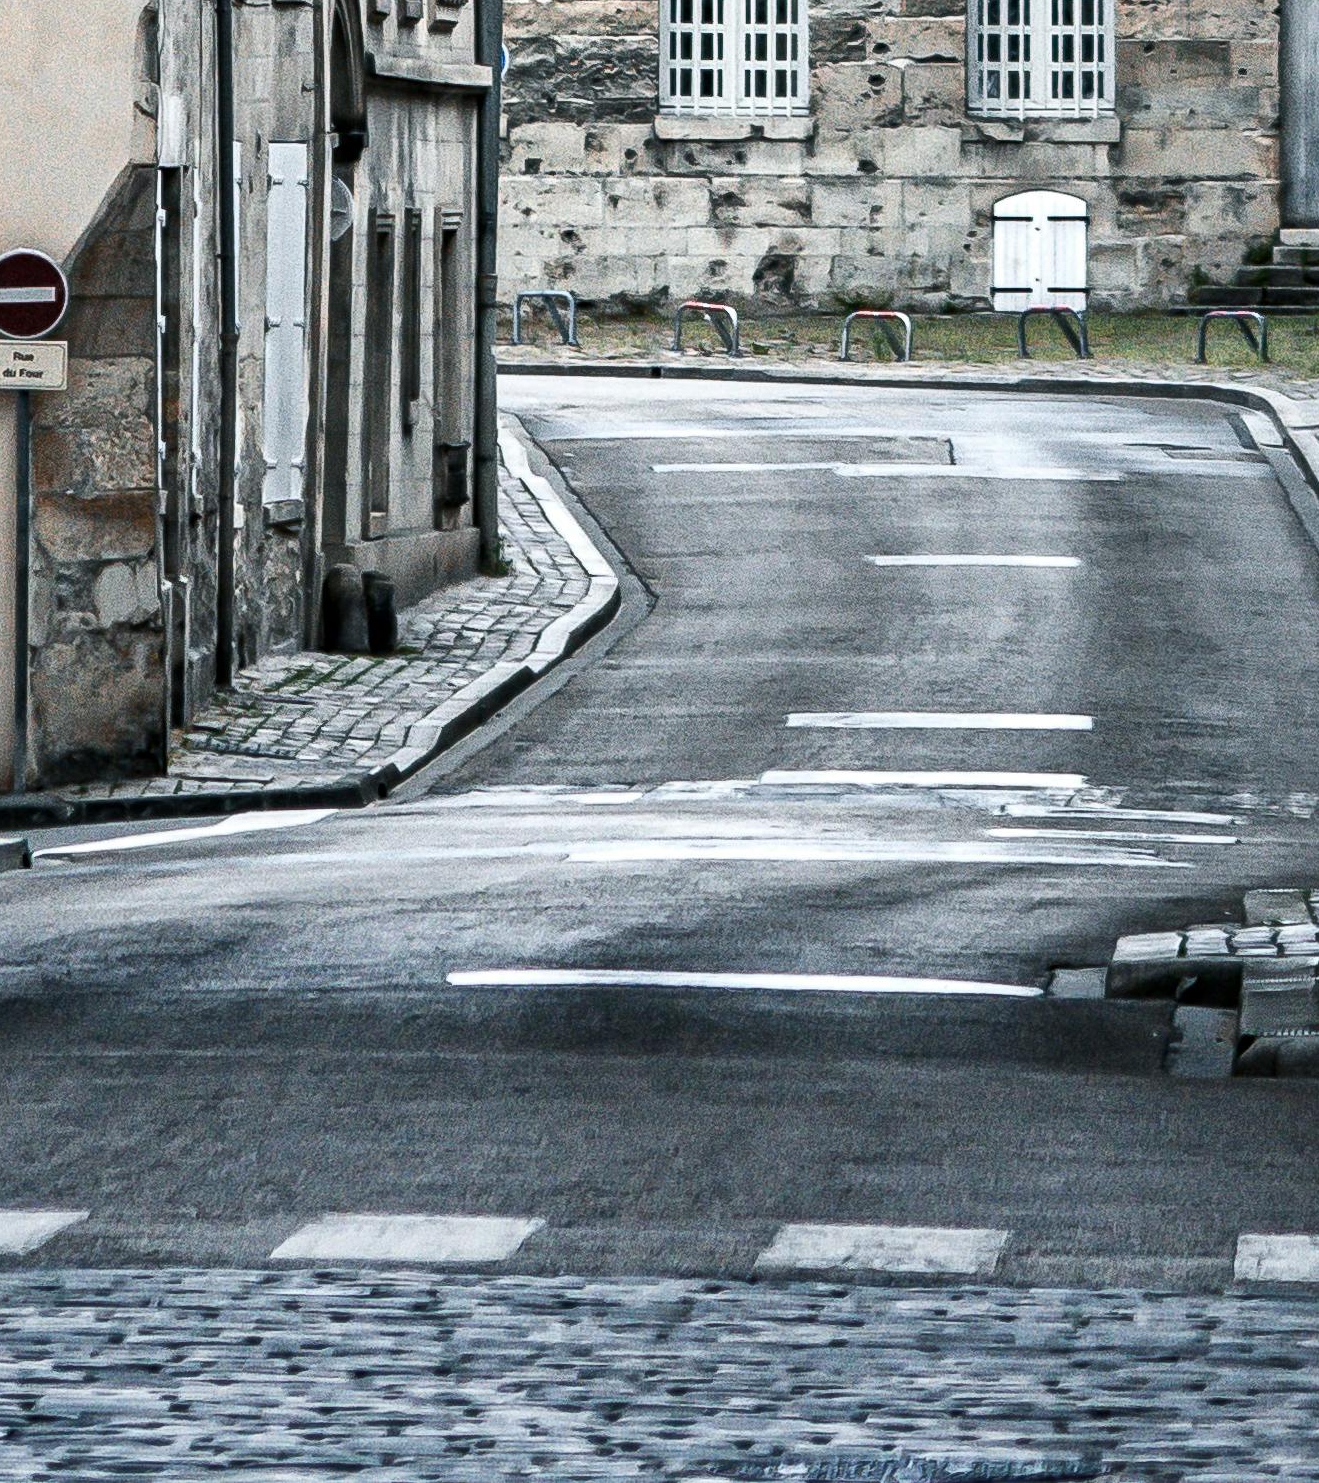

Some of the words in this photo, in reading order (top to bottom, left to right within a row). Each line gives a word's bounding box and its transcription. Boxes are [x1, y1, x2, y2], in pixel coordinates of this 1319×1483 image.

[12, 351, 35, 362] Rue
[2, 367, 16, 378] du
[19, 367, 44, 379] Four
